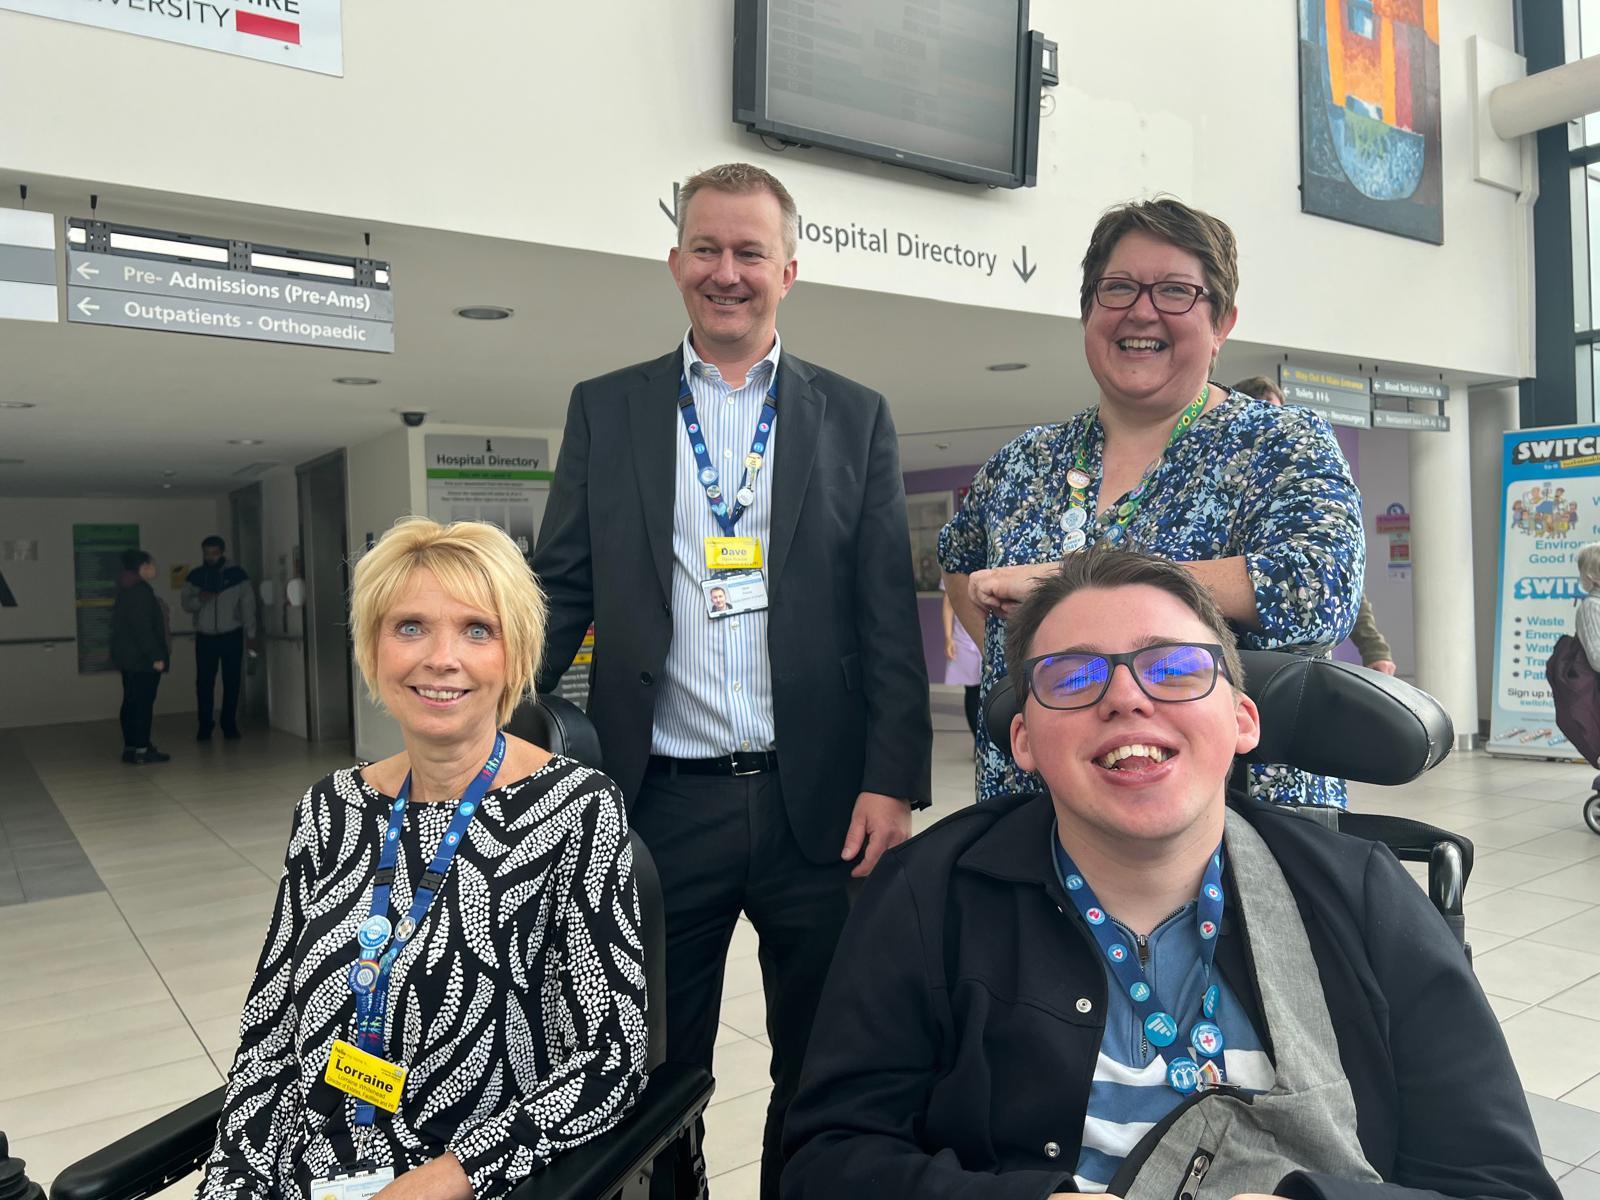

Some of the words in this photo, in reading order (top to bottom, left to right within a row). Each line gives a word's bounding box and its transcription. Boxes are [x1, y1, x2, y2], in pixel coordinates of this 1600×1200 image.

[897, 231, 997, 278] Directory
[124, 265, 163, 285] Pre-
[169, 270, 280, 300] Admissions
[285, 284, 371, 313] (Pre-Ams)
[124, 300, 241, 329] Outpatients
[258, 315, 367, 343] Orthopaedic
[436, 454, 485, 467] Hospital
[488, 455, 540, 469] Directory
[721, 547, 747, 556] Dave
[1529, 554, 1566, 564] Good
[1527, 615, 1565, 626] Waste
[1524, 656, 1548, 667] Tra
[1507, 688, 1529, 698] Sign
[1531, 690, 1545, 699] up
[335, 1058, 394, 1093] Lorraine
